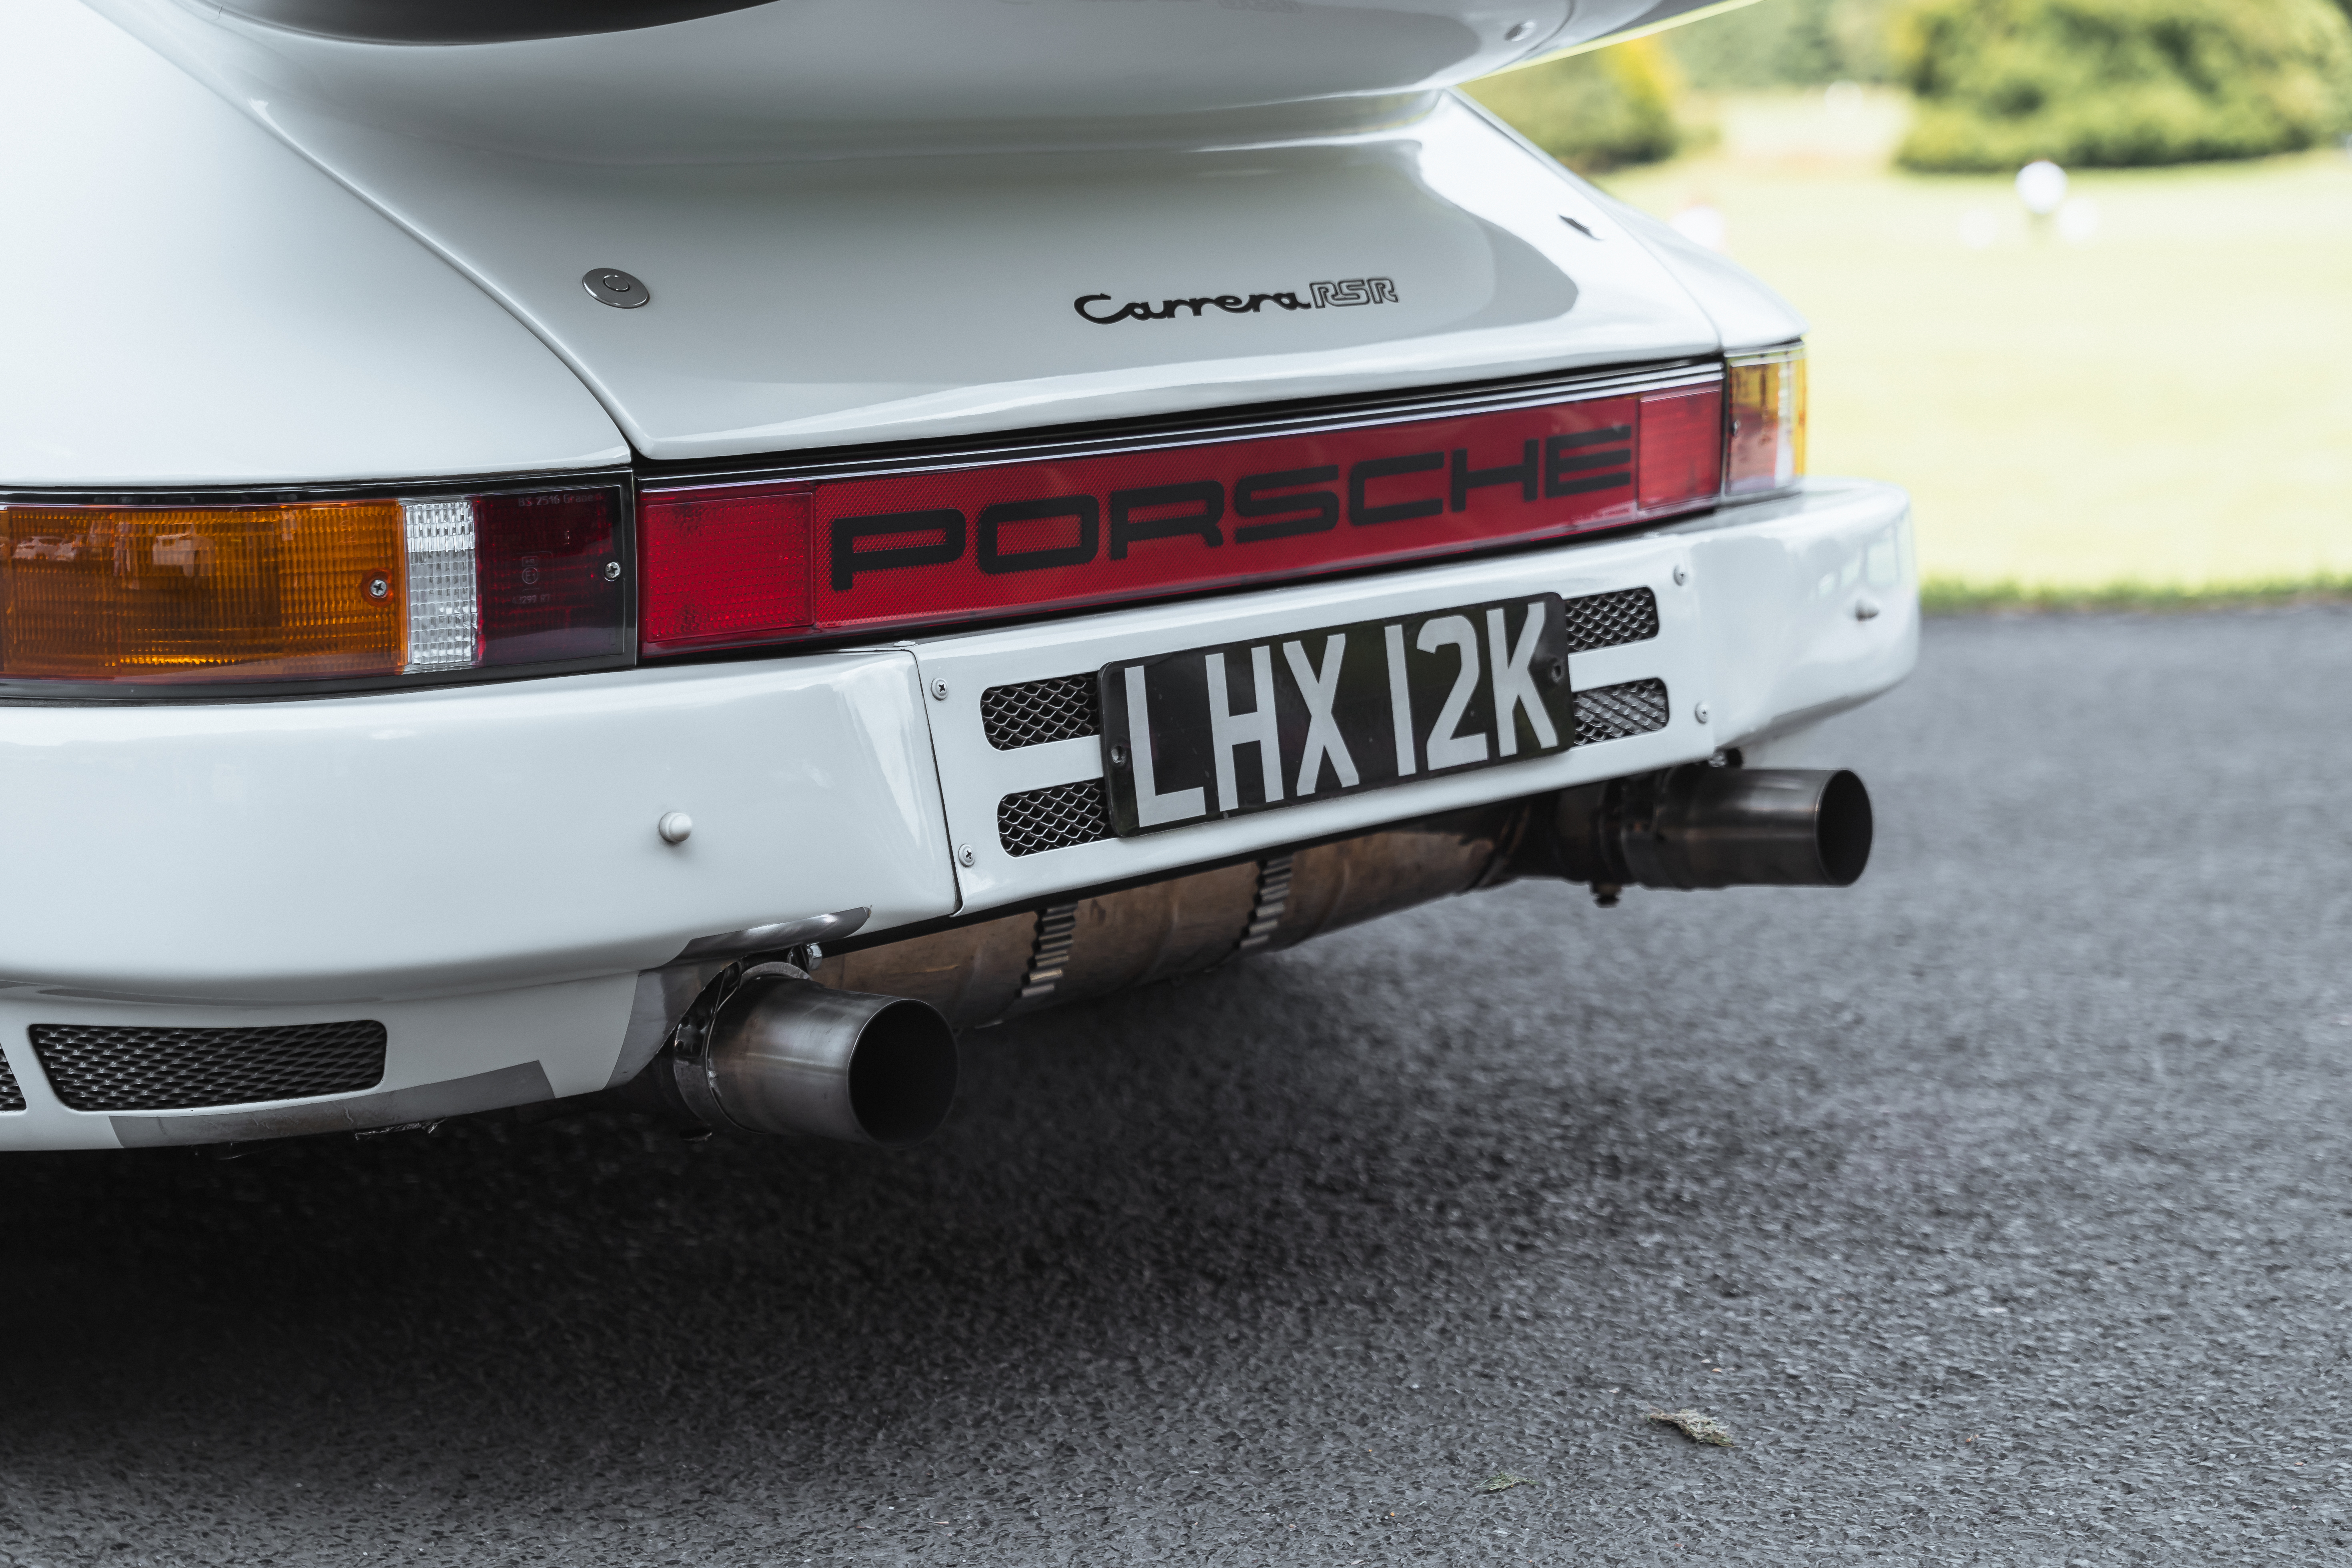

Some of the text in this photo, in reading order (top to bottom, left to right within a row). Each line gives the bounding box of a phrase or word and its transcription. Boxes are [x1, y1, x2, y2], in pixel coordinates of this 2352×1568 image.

[1073, 276, 1399, 325] Carrera RSR
[517, 497, 532, 507] BS
[535, 494, 560, 505] 2516
[830, 425, 1632, 592] PORSCHE
[1124, 601, 1558, 828] LHX 12K
